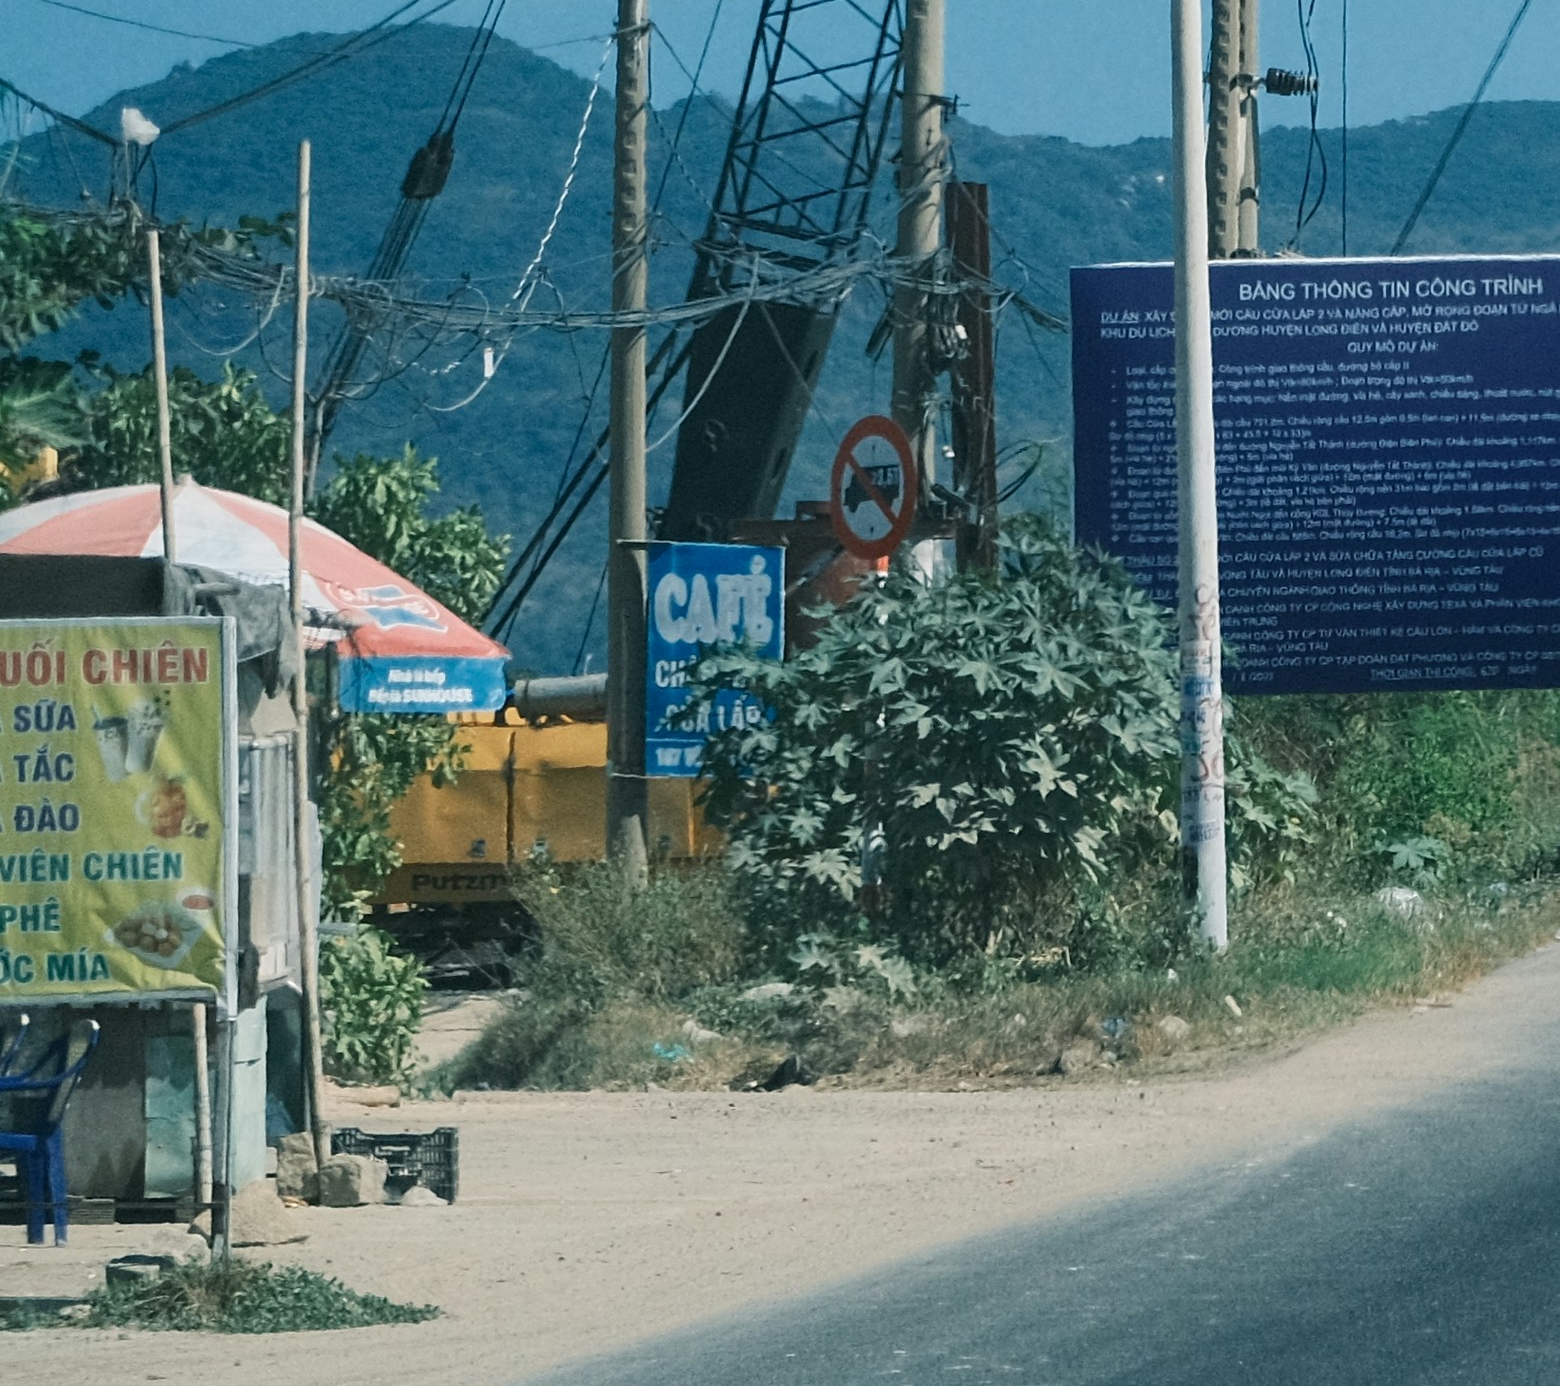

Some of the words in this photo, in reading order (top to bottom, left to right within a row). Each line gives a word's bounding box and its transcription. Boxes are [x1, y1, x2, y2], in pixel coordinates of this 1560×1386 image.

[1239, 280, 1295, 300] BẢNG
[1300, 280, 1372, 298] THÔNG
[1378, 280, 1409, 298] TIN
[1415, 277, 1476, 296] CÔNG
[1480, 274, 1543, 295] TRÌNH
[1305, 323, 1338, 335] LONG
[1317, 308, 1325, 319] 2
[82, 639, 209, 685] CHIÊN
[13, 699, 76, 733] SỮA
[13, 744, 74, 783] TẮC
[14, 798, 80, 833] ĐÀO
[0, 848, 69, 881] VIÊN
[83, 845, 182, 880] CHIÊN
[47, 947, 109, 981] MÍA
